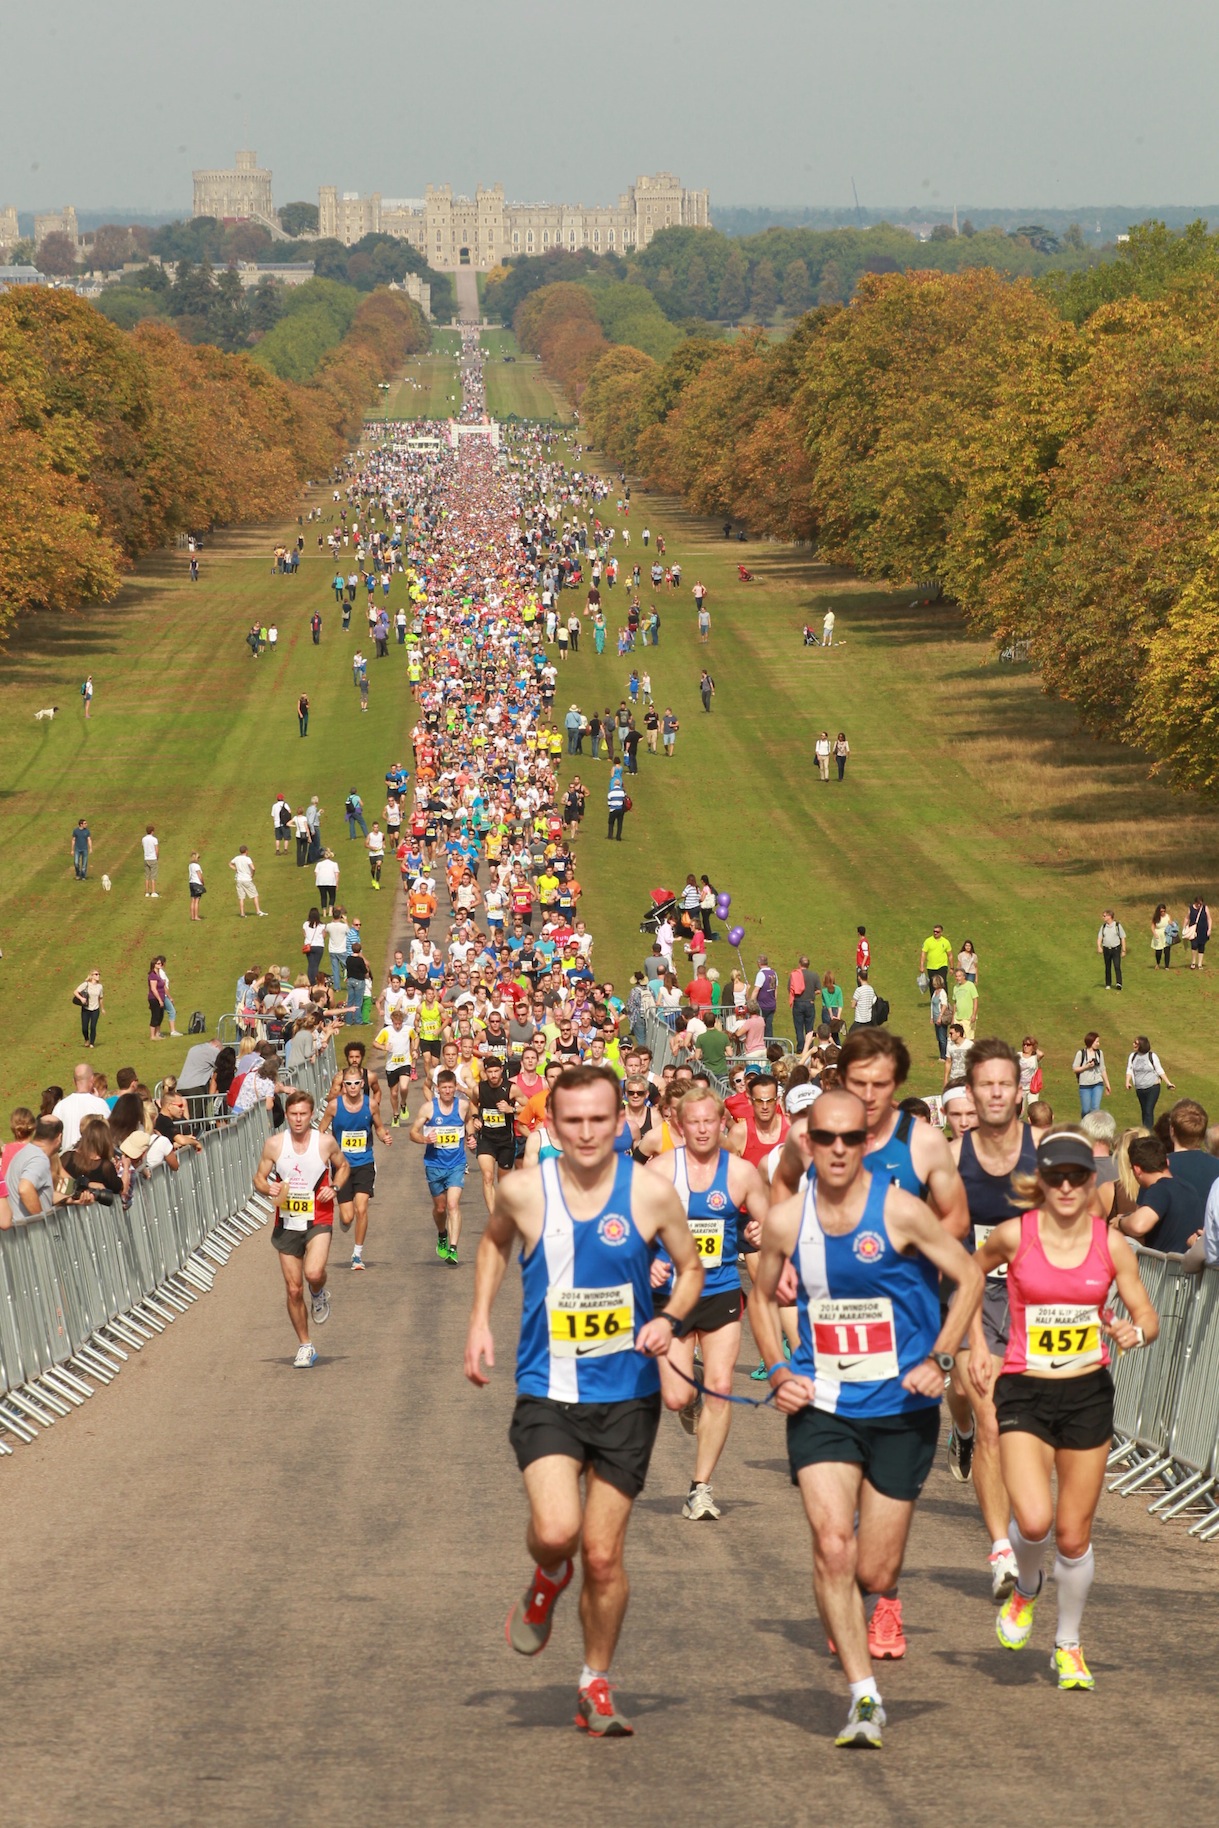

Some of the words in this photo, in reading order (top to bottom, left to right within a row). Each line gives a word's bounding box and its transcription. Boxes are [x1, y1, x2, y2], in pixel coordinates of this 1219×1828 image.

[346, 1139, 362, 1147] 421
[440, 1136, 456, 1144] 152
[286, 1201, 308, 1212] 108
[561, 1292, 581, 1300] 2014
[583, 1290, 621, 1300] WINDSOR
[579, 1299, 624, 1309] MARATHON
[821, 1304, 839, 1312] 2014
[842, 1303, 879, 1311] WINDSOR
[839, 1312, 883, 1320] MARATHON
[1038, 1308, 1056, 1316] 2014
[566, 1312, 620, 1338] 156
[834, 1324, 869, 1353] 11
[1038, 1327, 1090, 1352] 457
